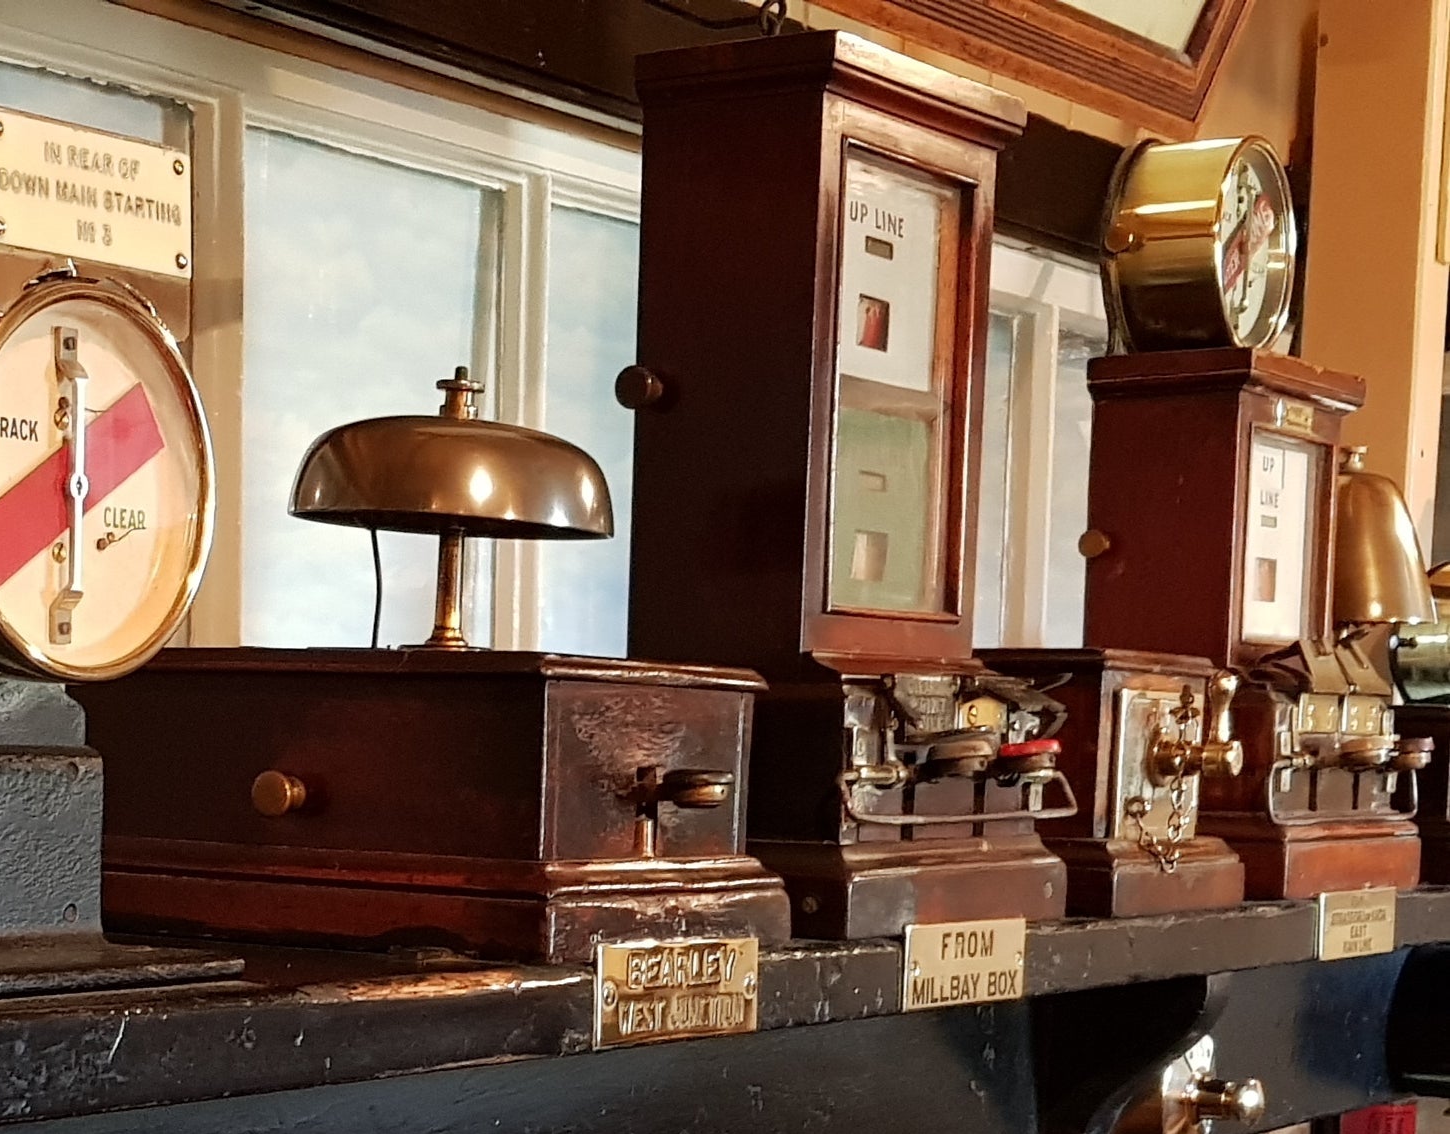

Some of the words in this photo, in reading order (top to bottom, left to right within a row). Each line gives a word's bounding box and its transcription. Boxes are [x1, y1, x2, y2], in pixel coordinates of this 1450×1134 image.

[44, 141, 63, 166] IN
[67, 144, 114, 179] REAR
[118, 157, 141, 182] OF
[56, 179, 98, 209] MAIN
[103, 190, 183, 227] STARTING
[849, 200, 869, 224] UP
[875, 208, 904, 239] LINE
[1262, 455, 1275, 473] UP
[1260, 489, 1279, 509] LINE
[103, 506, 147, 530] CLEAR
[941, 929, 994, 961] FROM
[627, 945, 738, 990] BEARLEY
[911, 972, 981, 1006] MILLBAY
[987, 969, 1018, 997] BOX
[618, 1001, 666, 1036] WEST
